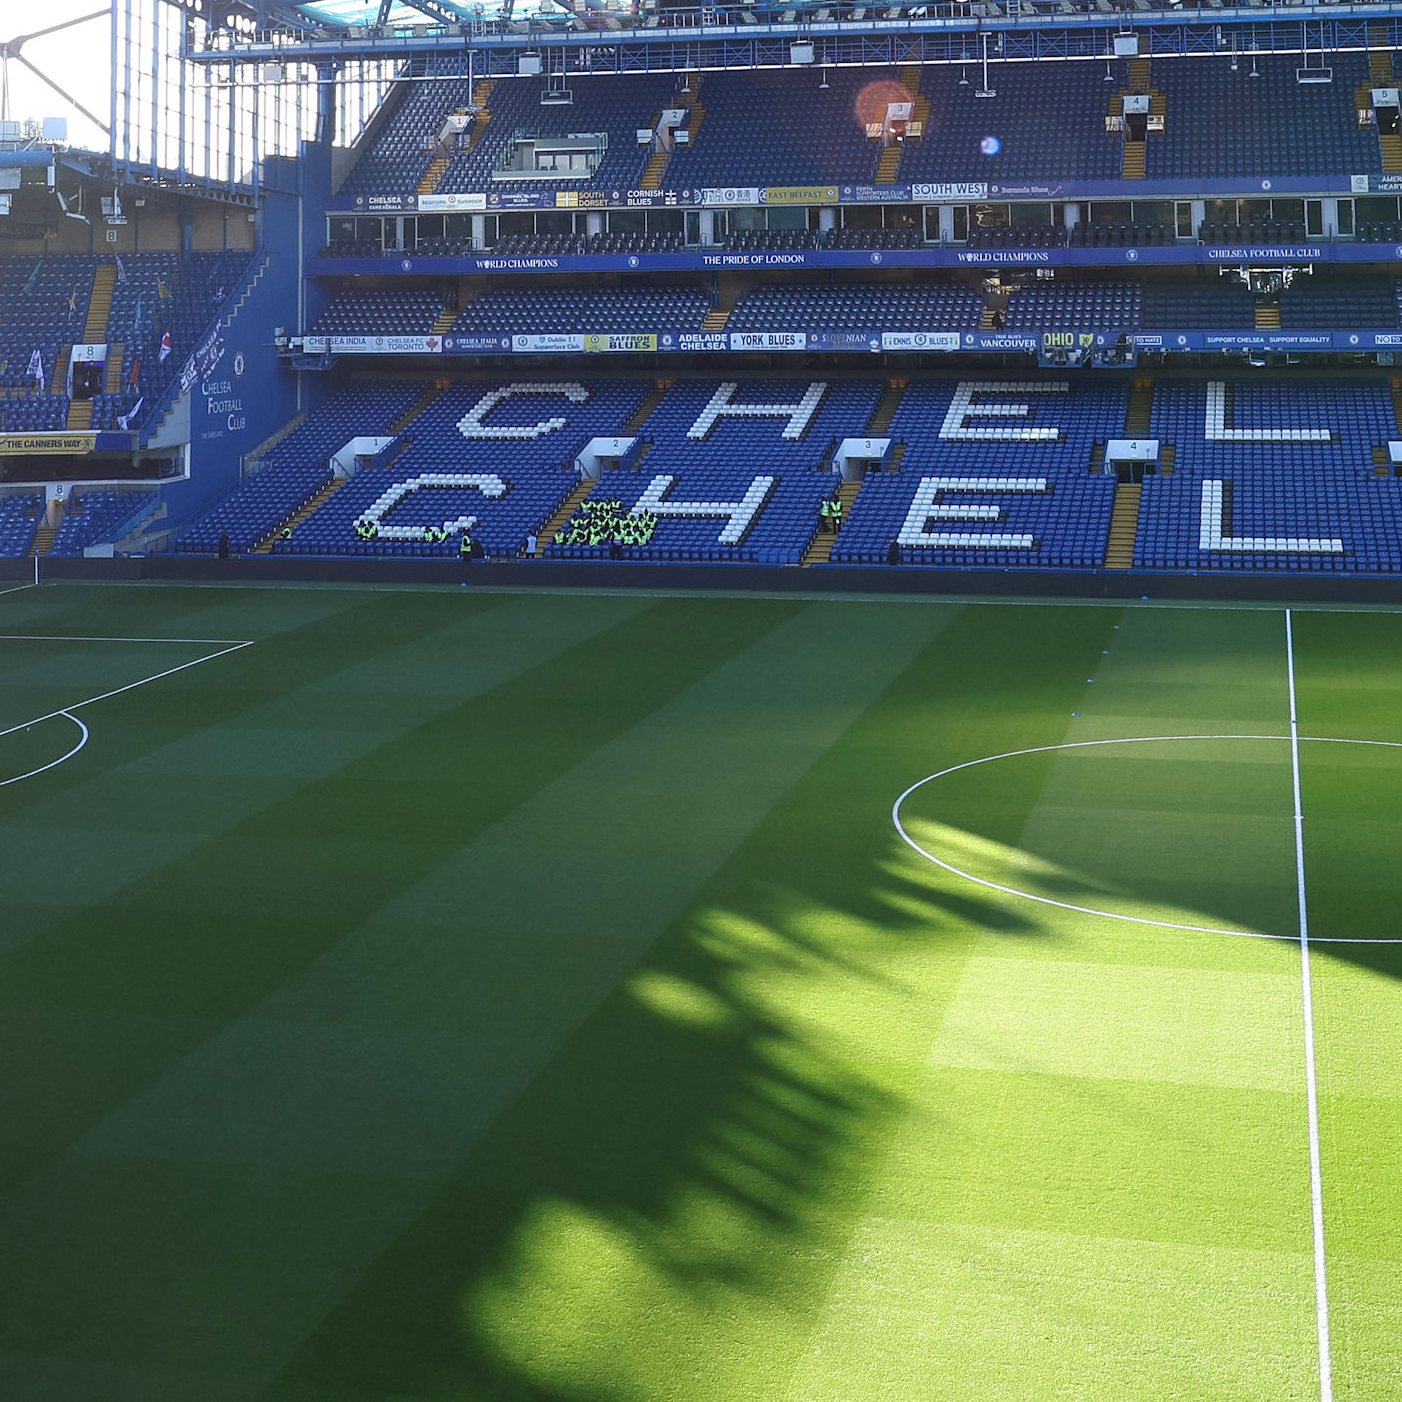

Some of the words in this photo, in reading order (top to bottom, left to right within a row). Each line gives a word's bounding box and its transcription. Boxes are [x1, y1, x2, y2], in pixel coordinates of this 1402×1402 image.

[1382, 90, 1388, 98] 5
[914, 184, 950, 194] SOUTH
[957, 184, 986, 194] WEST
[368, 196, 402, 204] CHELSEA
[108, 231, 115, 241] 8
[957, 252, 991, 262] WORLD
[992, 252, 1049, 262] CHAMPIONS
[1208, 249, 1246, 258] CHELSEA
[1248, 248, 1296, 258] FOOTBALL
[1298, 248, 1321, 258] CLUB
[476, 259, 506, 270] WORLD
[508, 258, 558, 268] CHAMPIONS
[703, 256, 720, 265] THE
[721, 255, 748, 265] PRIDE
[749, 255, 763, 264] OF
[765, 254, 805, 264] LONDON
[346, 337, 366, 345] INDIA
[678, 334, 727, 342] ADELAIDE
[740, 334, 766, 346] YORK
[768, 334, 796, 345] BLUES
[893, 337, 912, 345] ENNIS
[929, 337, 949, 345] BLUES
[1044, 333, 1074, 346] OHIO
[680, 342, 726, 351] CHELSEA
[980, 340, 1036, 348] VANCOUVER
[86, 346, 94, 356] 8
[202, 381, 232, 396] CHELSEA
[208, 397, 242, 414] FOOTBALL
[227, 414, 246, 431] CLUB
[6, 439, 22, 449] THE
[24, 438, 63, 449] CANNERS
[64, 438, 81, 448] WAY
[865, 440, 871, 448] 3
[56, 484, 62, 494] 8
